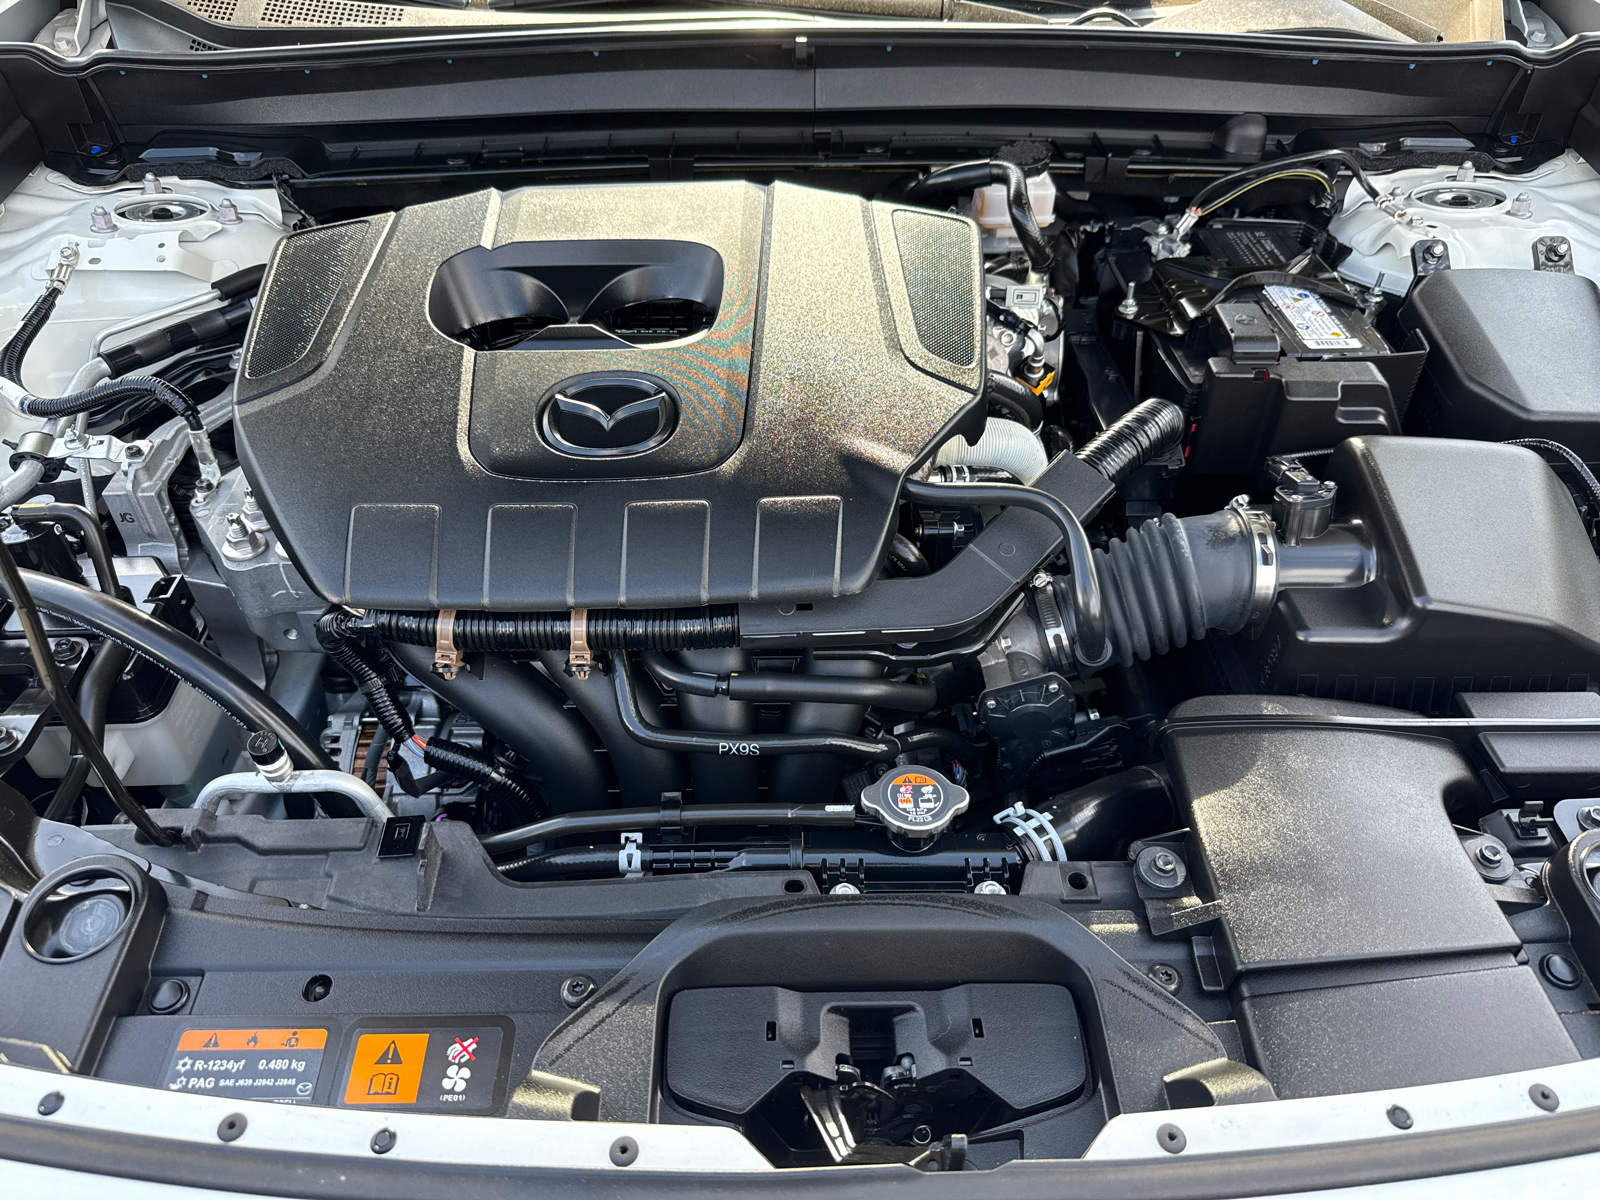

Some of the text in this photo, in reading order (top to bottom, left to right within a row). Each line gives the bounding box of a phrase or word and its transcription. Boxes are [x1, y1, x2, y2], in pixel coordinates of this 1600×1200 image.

[718, 742, 760, 756] PX9S
[193, 1058, 306, 1073] R-1234yf 0.480 kg
[187, 1077, 215, 1089] PAG
[219, 1078, 236, 1086] SAE
[235, 1078, 253, 1086] J639
[275, 1078, 296, 1086] J2845
[440, 1094, 466, 1102] (PE01)
